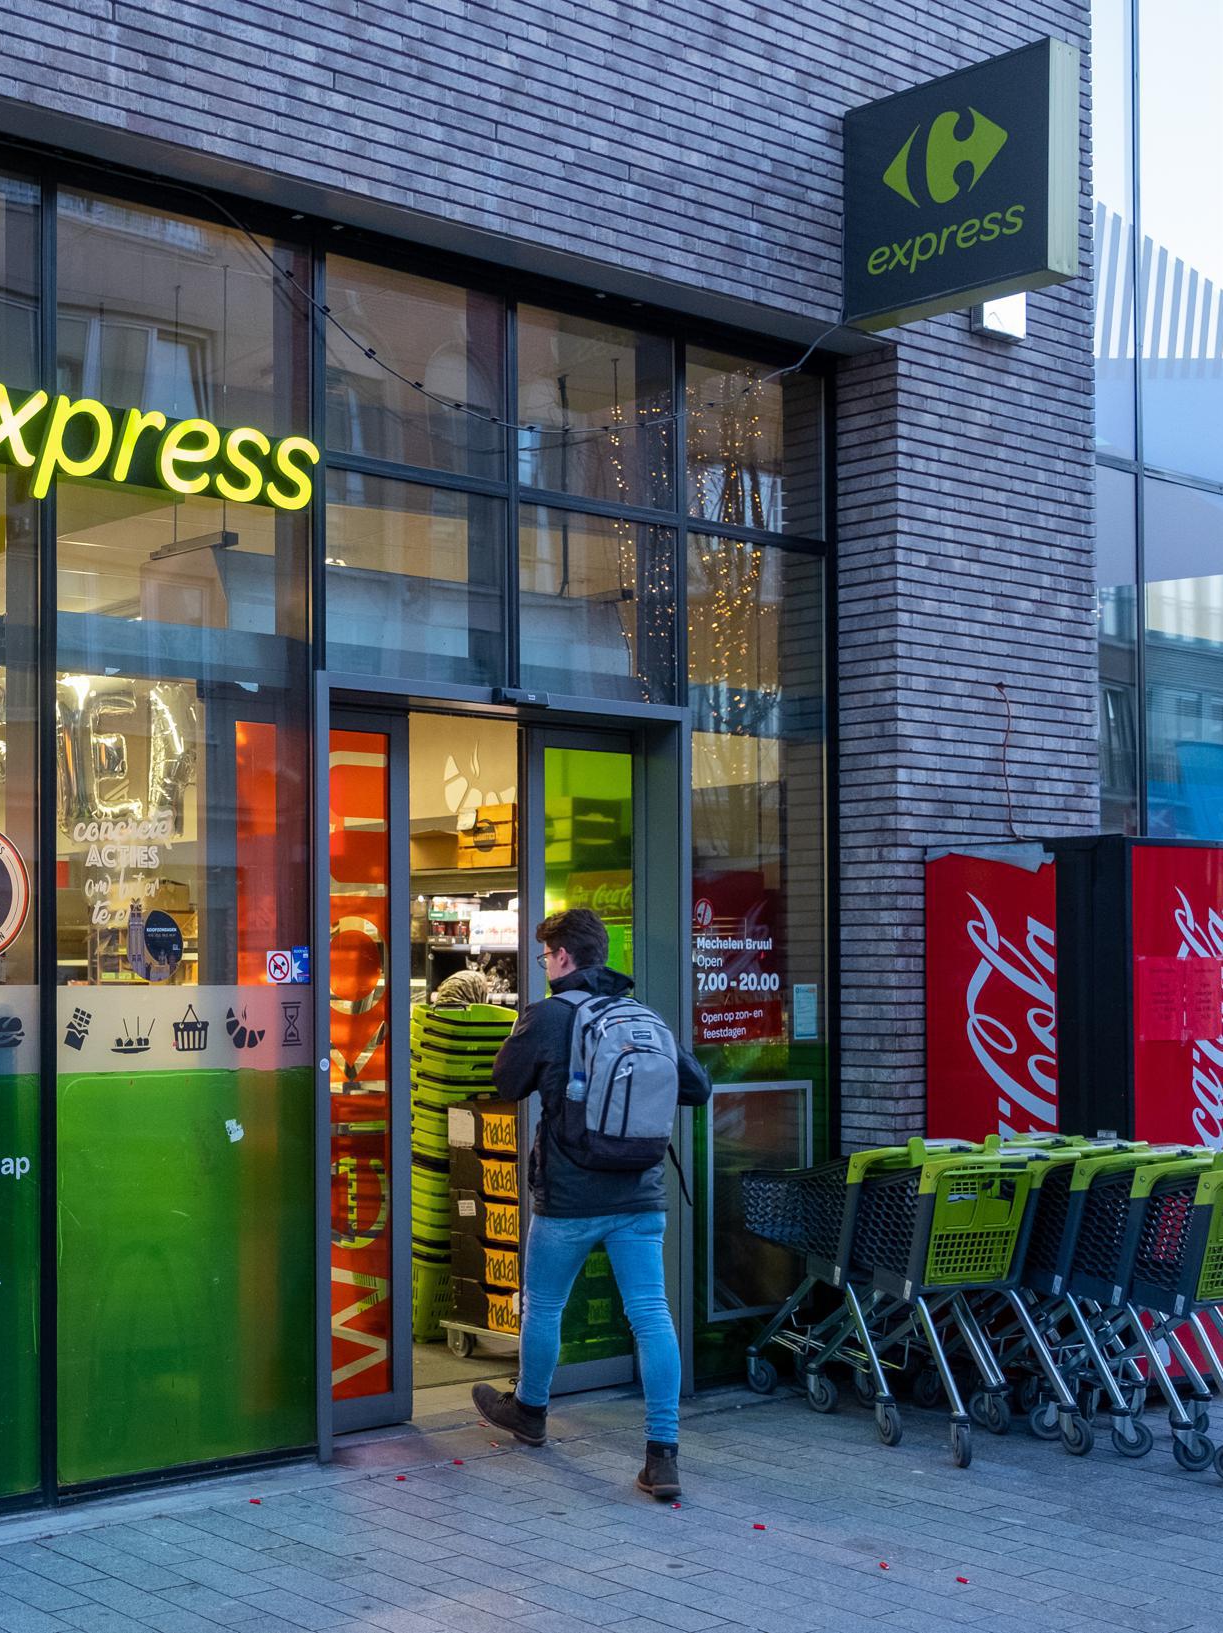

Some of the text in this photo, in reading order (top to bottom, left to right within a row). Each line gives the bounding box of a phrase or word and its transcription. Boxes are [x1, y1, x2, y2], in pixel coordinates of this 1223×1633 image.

[867, 204, 1025, 275] express
[73, 810, 173, 849] concrete
[85, 845, 160, 869] ACTIES
[697, 937, 773, 950] Mechelen Bruul
[697, 955, 723, 969] Open
[697, 972, 728, 991] 7.00
[739, 973, 780, 991] 20.00
[701, 1009, 763, 1024] Open op zon- en
[703, 1026, 747, 1039] feestdagen
